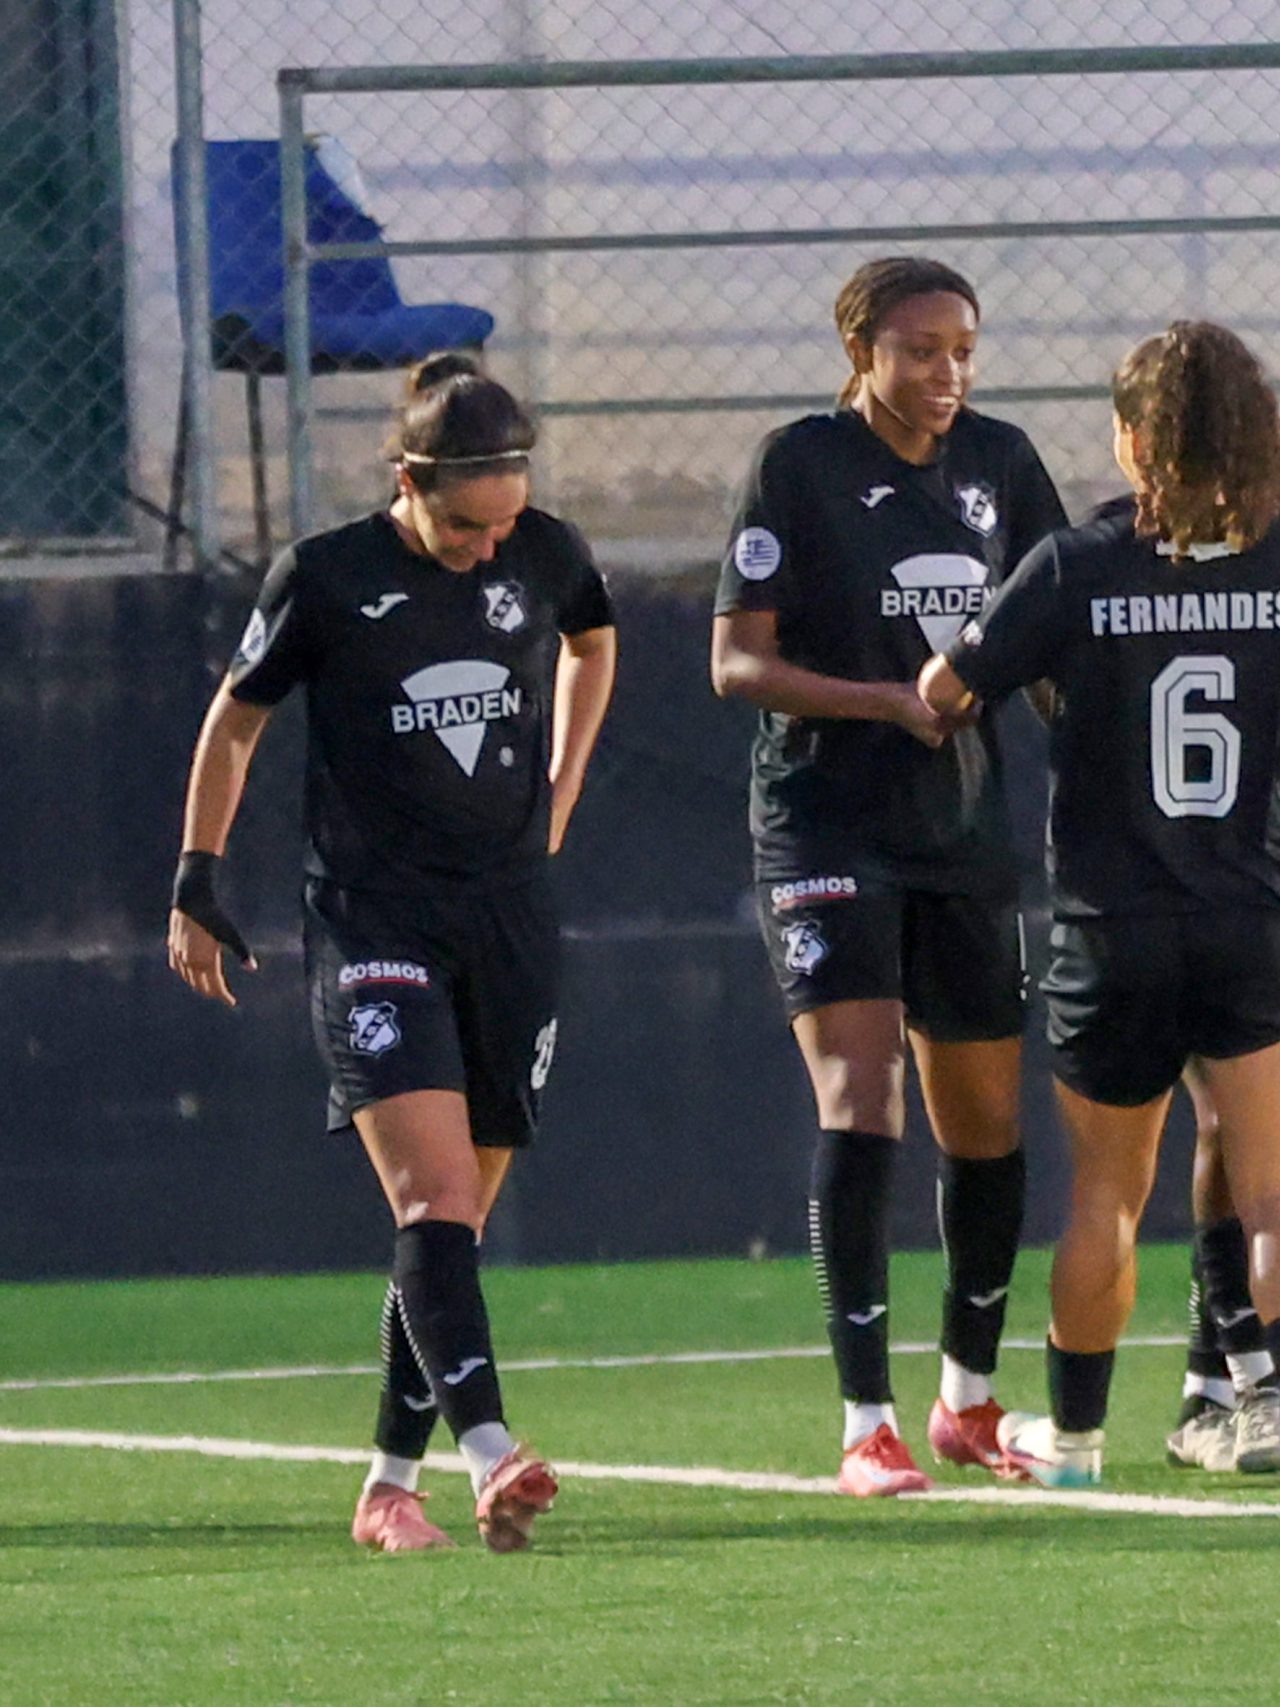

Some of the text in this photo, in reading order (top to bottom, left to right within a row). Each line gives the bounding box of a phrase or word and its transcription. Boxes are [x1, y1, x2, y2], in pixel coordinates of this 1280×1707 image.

[391, 688, 522, 733] BRADEN
[1151, 655, 1242, 818] 6
[771, 877, 857, 904] COSMOS
[338, 961, 429, 984] COSMOS
